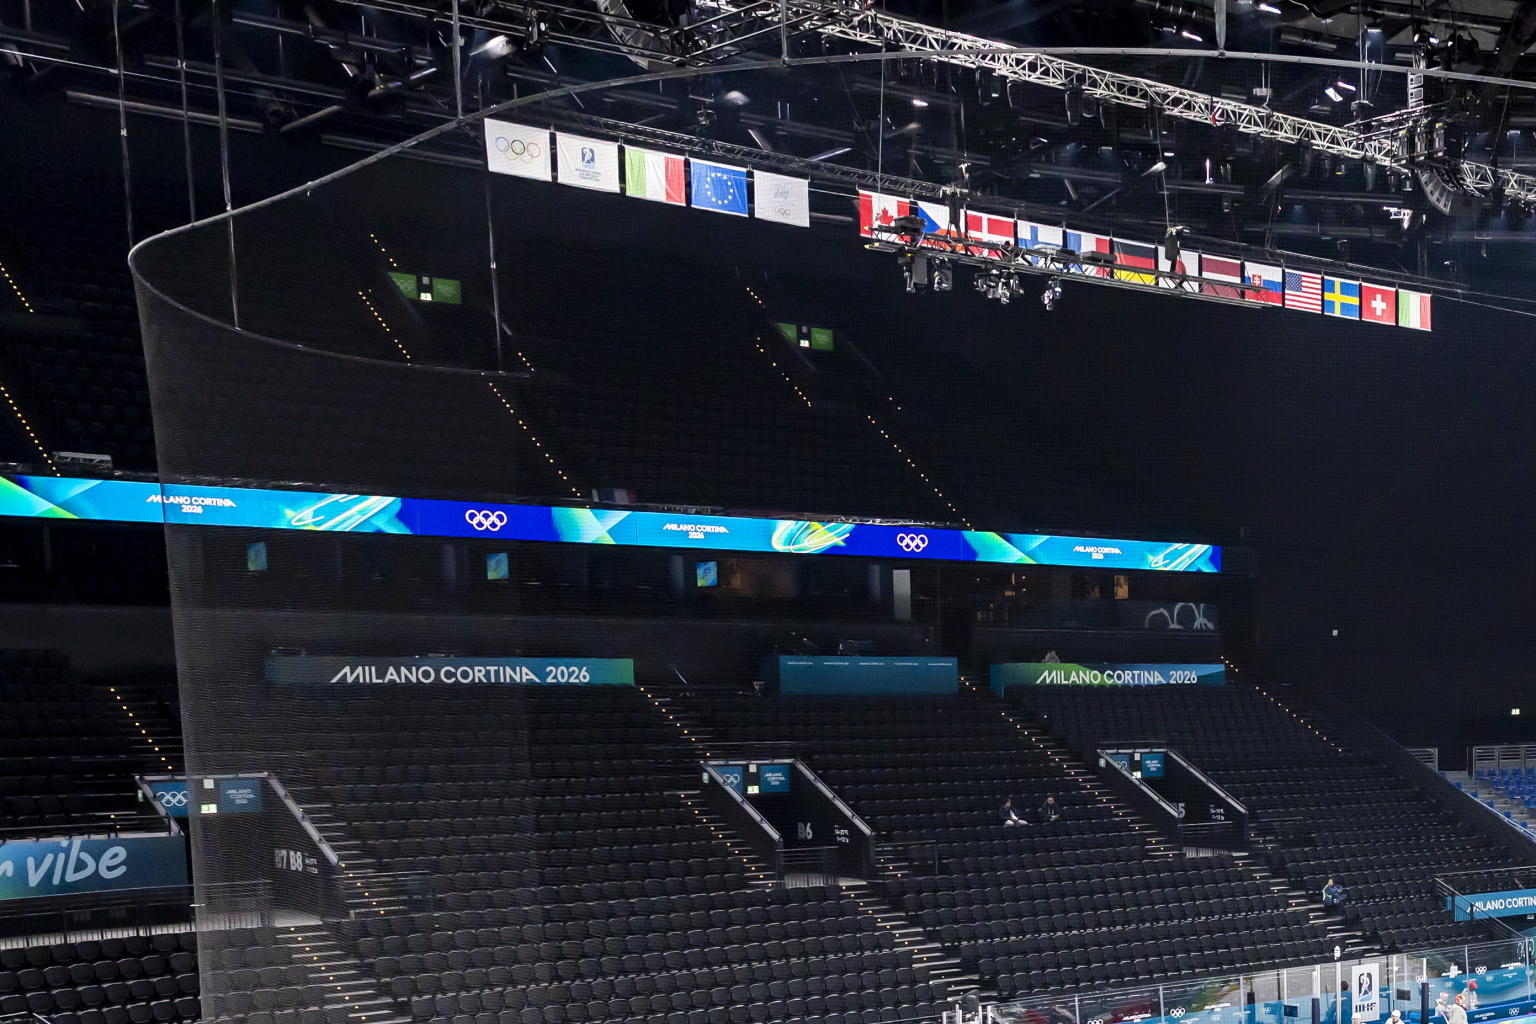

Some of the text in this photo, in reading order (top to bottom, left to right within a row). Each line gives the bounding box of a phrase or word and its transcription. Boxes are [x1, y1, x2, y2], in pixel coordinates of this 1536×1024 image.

[146, 494, 236, 508] MILANO CORTINA
[181, 504, 203, 514] 2026
[663, 523, 729, 534] MILANO CORTINA
[330, 665, 590, 684] MILANO CORTINA 2026
[1036, 670, 1198, 684] MILANO CORTINA 2026
[797, 822, 813, 839] B6
[26, 838, 128, 887] vibe
[290, 851, 303, 871] B8
[1467, 899, 1505, 913] MILANO
[1355, 1002, 1376, 1013] IIHF
